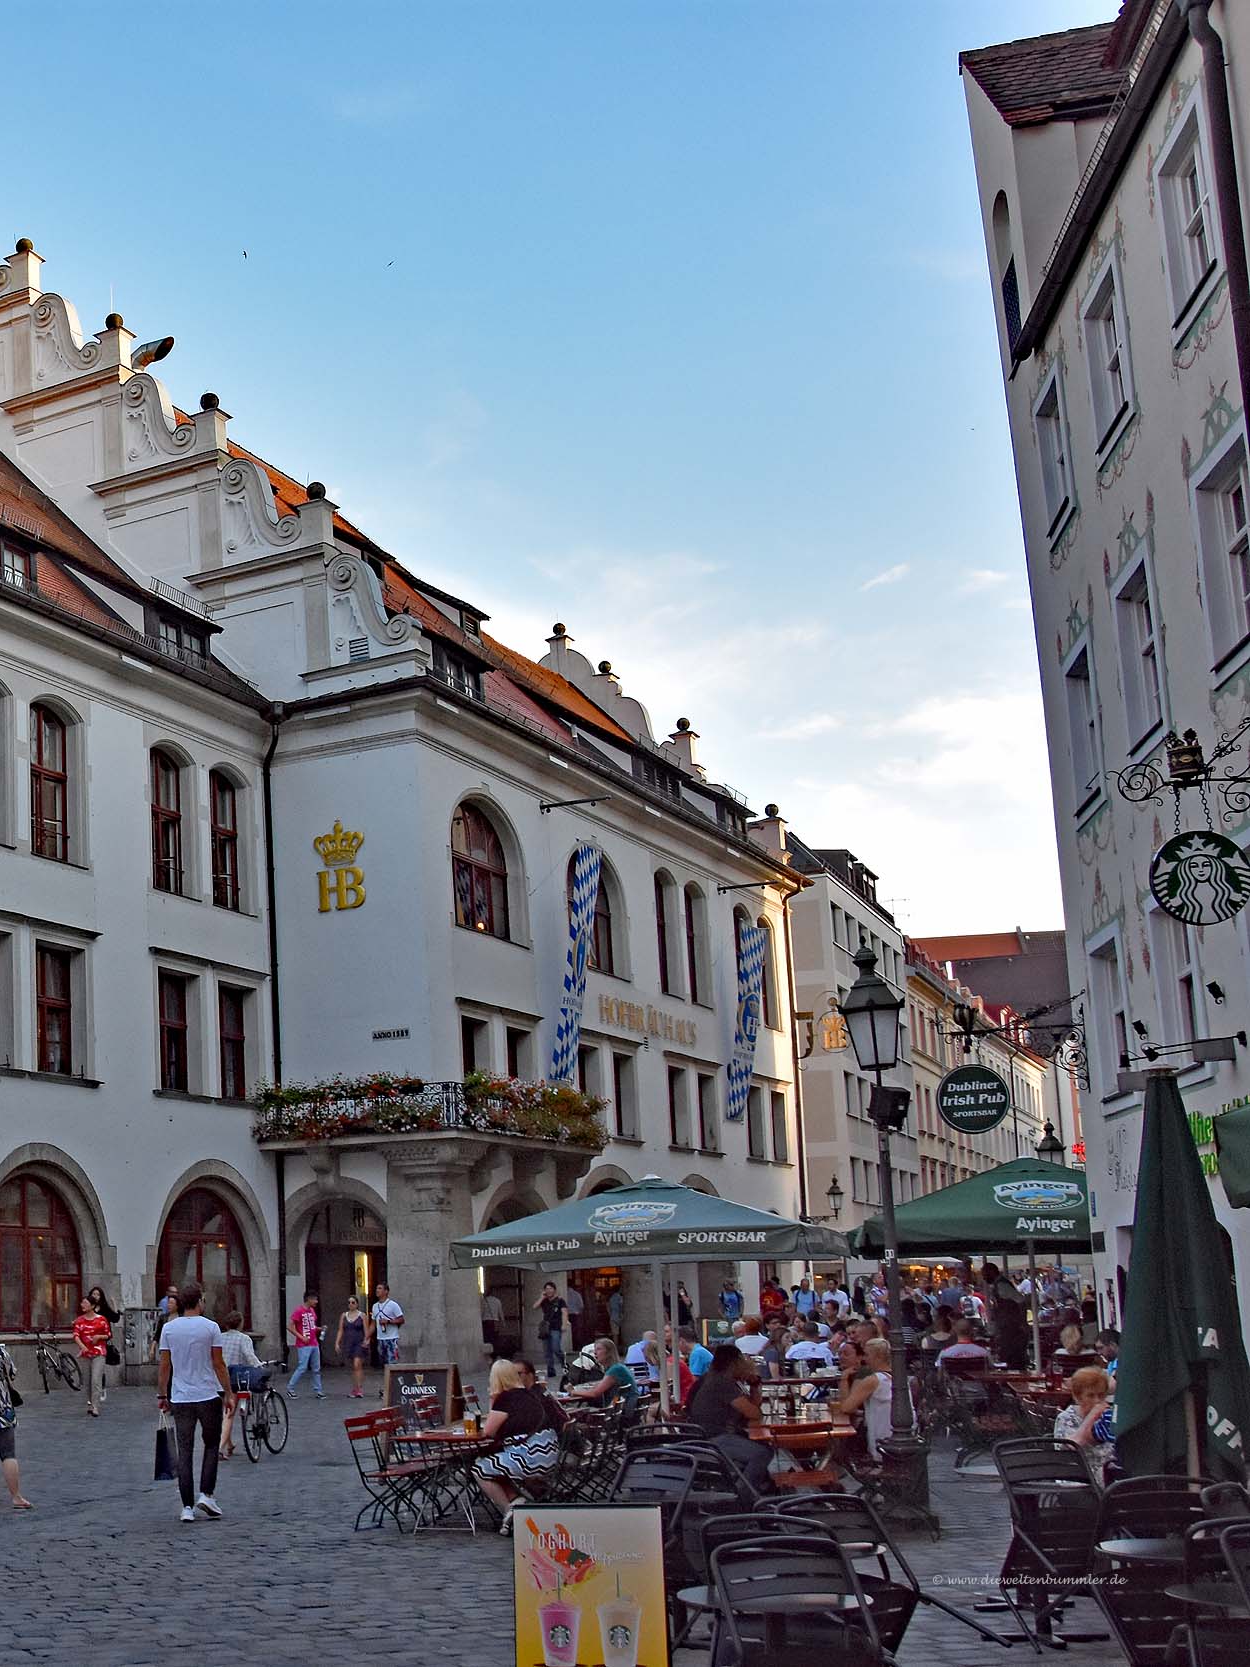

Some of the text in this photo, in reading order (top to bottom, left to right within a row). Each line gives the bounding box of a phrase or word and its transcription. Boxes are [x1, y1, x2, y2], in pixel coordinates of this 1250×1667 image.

[317, 866, 366, 912] HB
[947, 1081, 999, 1092] Dubliner
[942, 1092, 1006, 1107] Irish Pub
[953, 1109, 997, 1118] SPORTSBAR
[1000, 1182, 1075, 1192] Ayinger
[1015, 1216, 1076, 1233] Ayinger
[593, 1230, 650, 1247] Ayinger
[677, 1231, 767, 1244] SPORTSBAR
[471, 1239, 580, 1258] Dubliner Irish Pub
[401, 1385, 437, 1395] GUINNESS
[527, 1533, 599, 1550] YOGHURT
